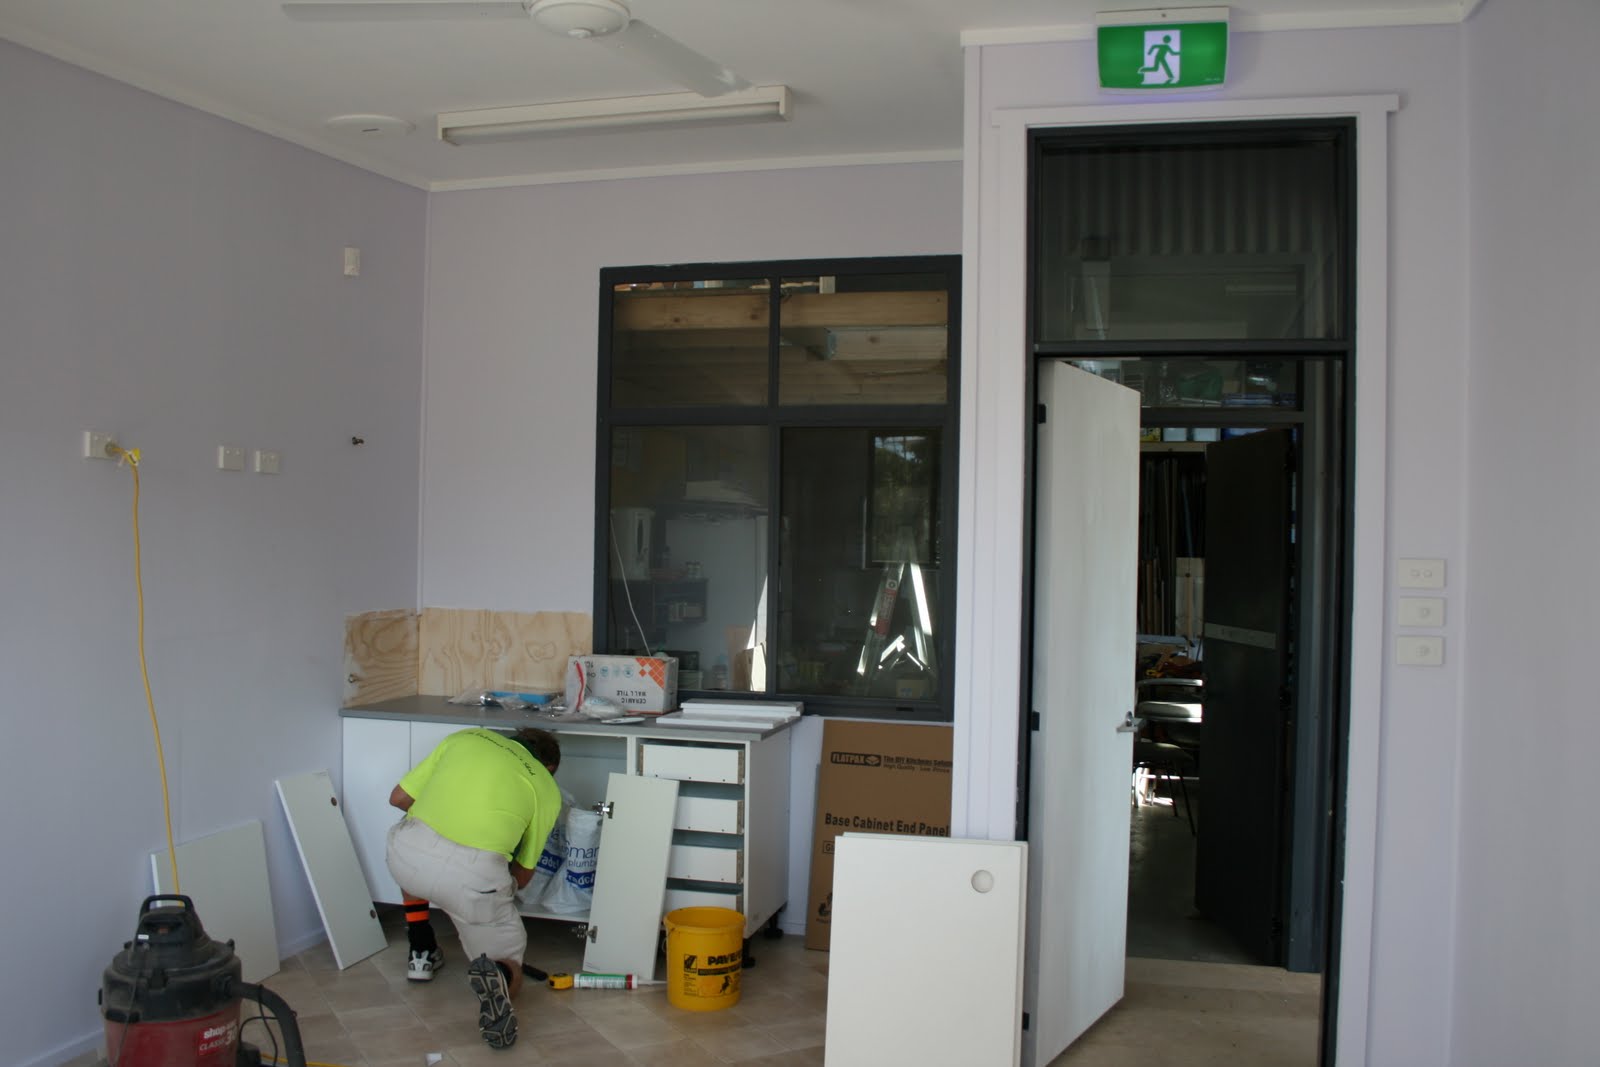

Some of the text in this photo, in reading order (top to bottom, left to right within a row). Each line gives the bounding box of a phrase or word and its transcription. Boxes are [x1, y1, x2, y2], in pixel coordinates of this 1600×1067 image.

[825, 813, 949, 837] Base Cabinet End Panel
